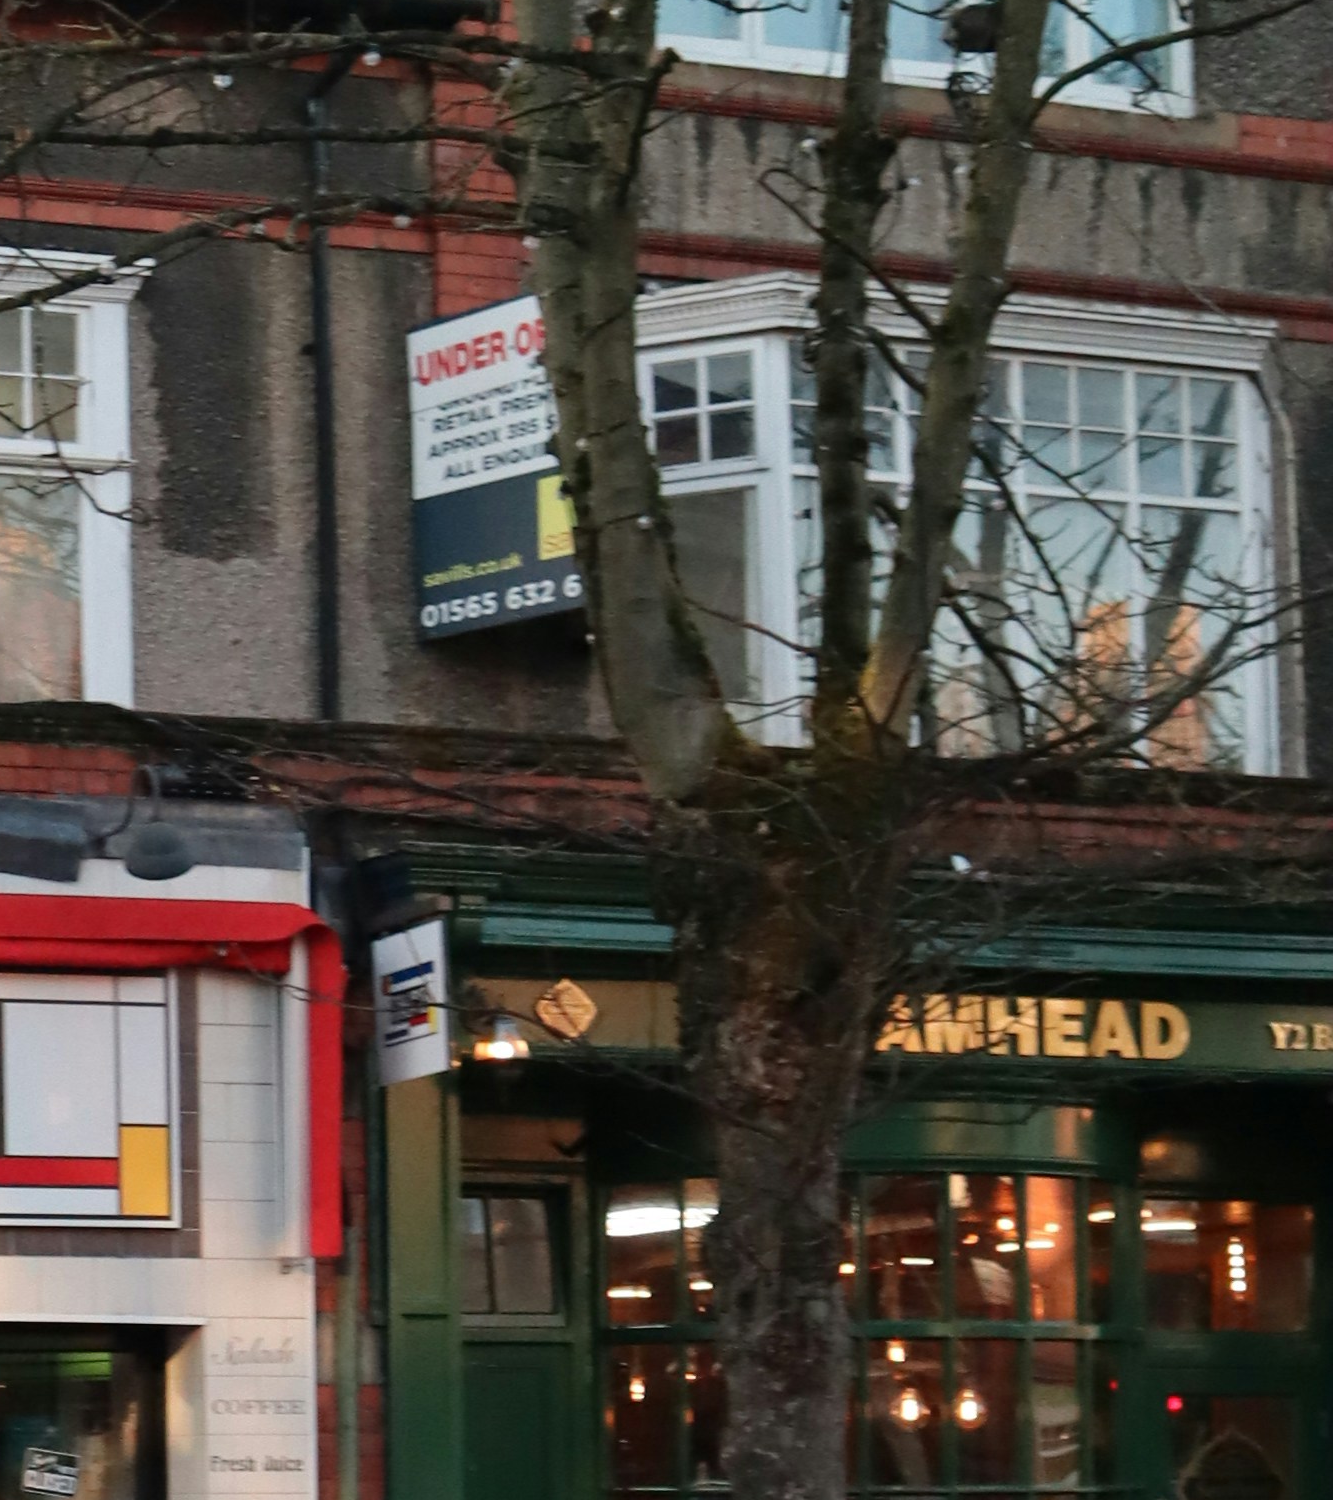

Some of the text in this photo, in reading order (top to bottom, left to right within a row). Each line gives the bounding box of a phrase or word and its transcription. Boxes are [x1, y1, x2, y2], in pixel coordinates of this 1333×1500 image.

[416, 331, 507, 385] UNDER
[420, 591, 499, 628] 01565
[505, 580, 556, 610] 632
[211, 1399, 307, 1415] COFFEE
[209, 1456, 257, 1472] Fresh
